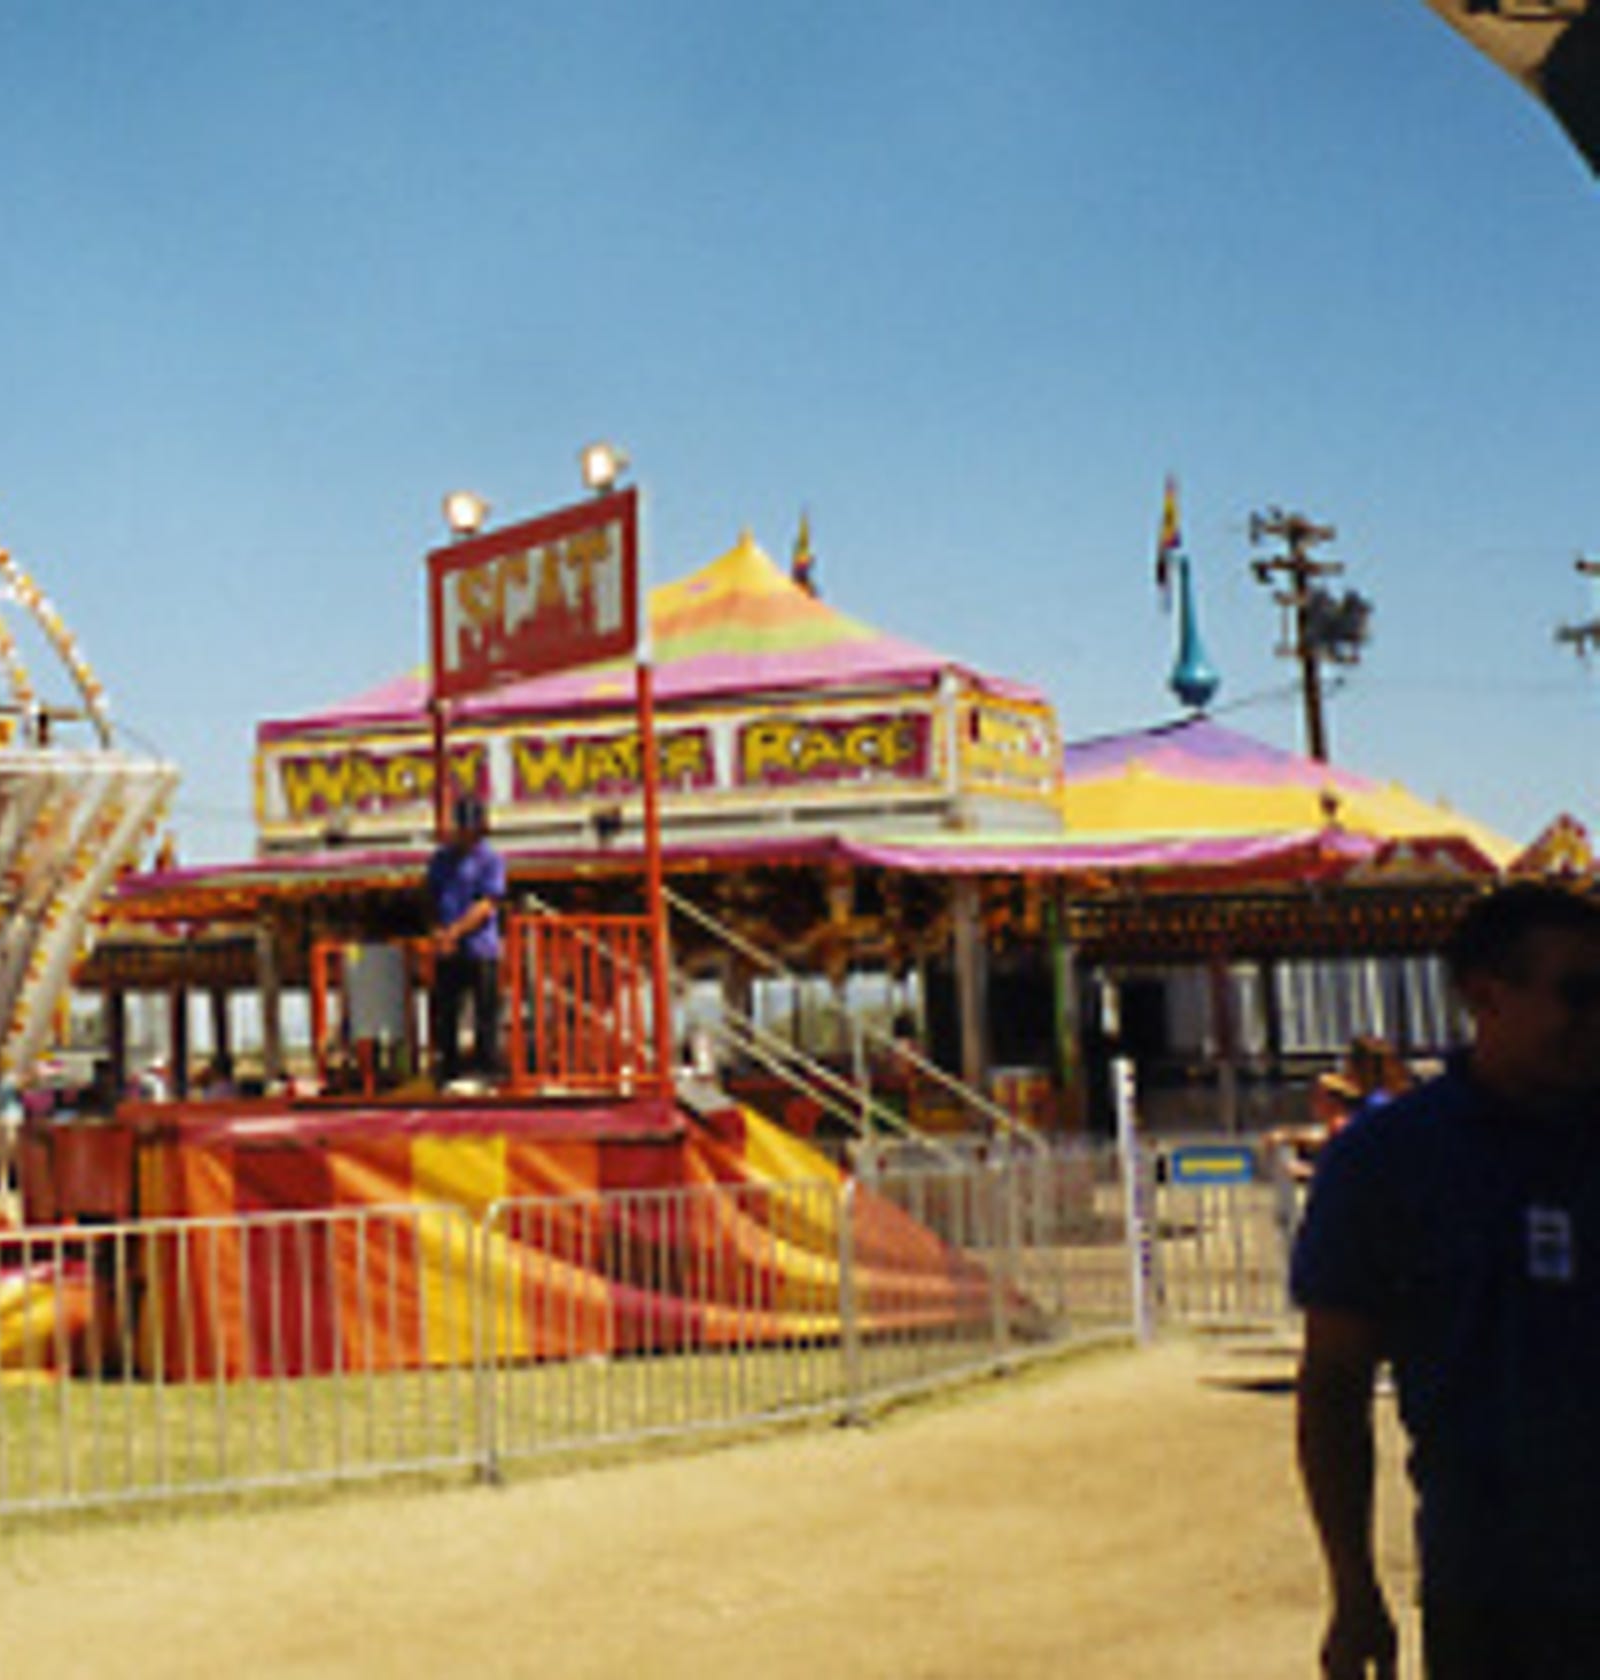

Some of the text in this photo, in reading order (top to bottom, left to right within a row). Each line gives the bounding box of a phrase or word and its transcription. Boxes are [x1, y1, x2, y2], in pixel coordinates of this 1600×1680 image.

[456, 527, 612, 665] SCAT
[512, 733, 703, 794] WATR
[743, 716, 918, 779] RACE
